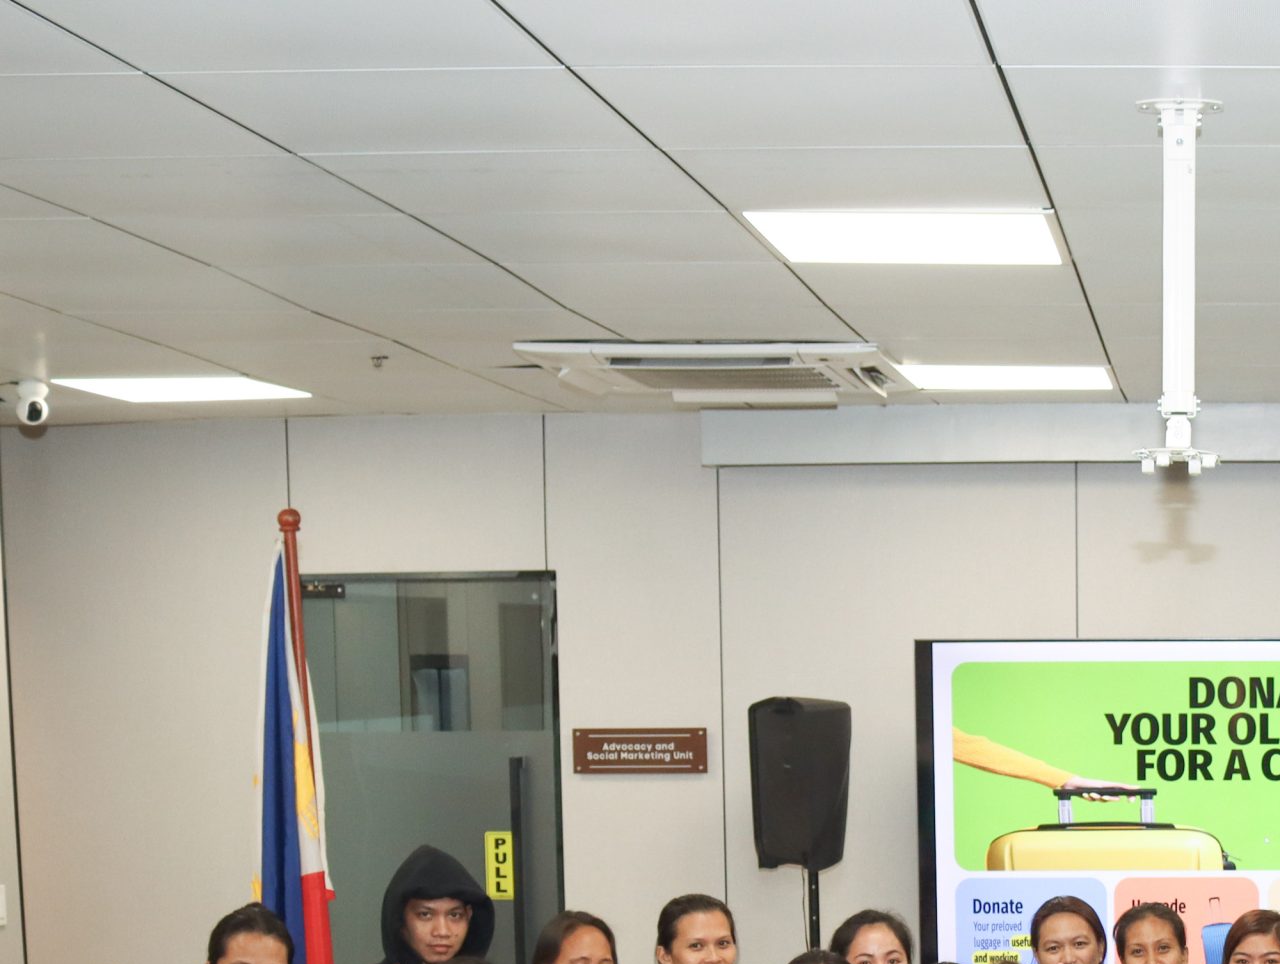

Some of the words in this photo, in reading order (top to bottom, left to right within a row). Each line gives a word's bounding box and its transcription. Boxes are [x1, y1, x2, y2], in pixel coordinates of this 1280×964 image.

[1104, 712, 1217, 746] YOUR
[602, 742, 652, 752] Advocacy
[655, 742, 675, 751] and
[586, 751, 618, 760] Social
[620, 751, 671, 762] Marketing
[673, 751, 693, 760] Unit
[1136, 749, 1214, 781] FOR
[1223, 749, 1251, 781] A
[494, 838, 508, 893] PULL
[973, 898, 1024, 914] Donate
[973, 921, 989, 932] Your
[991, 921, 1022, 934] preloved
[973, 936, 1002, 950] luggage
[1003, 937, 1010, 947] in
[974, 953, 988, 963] and
